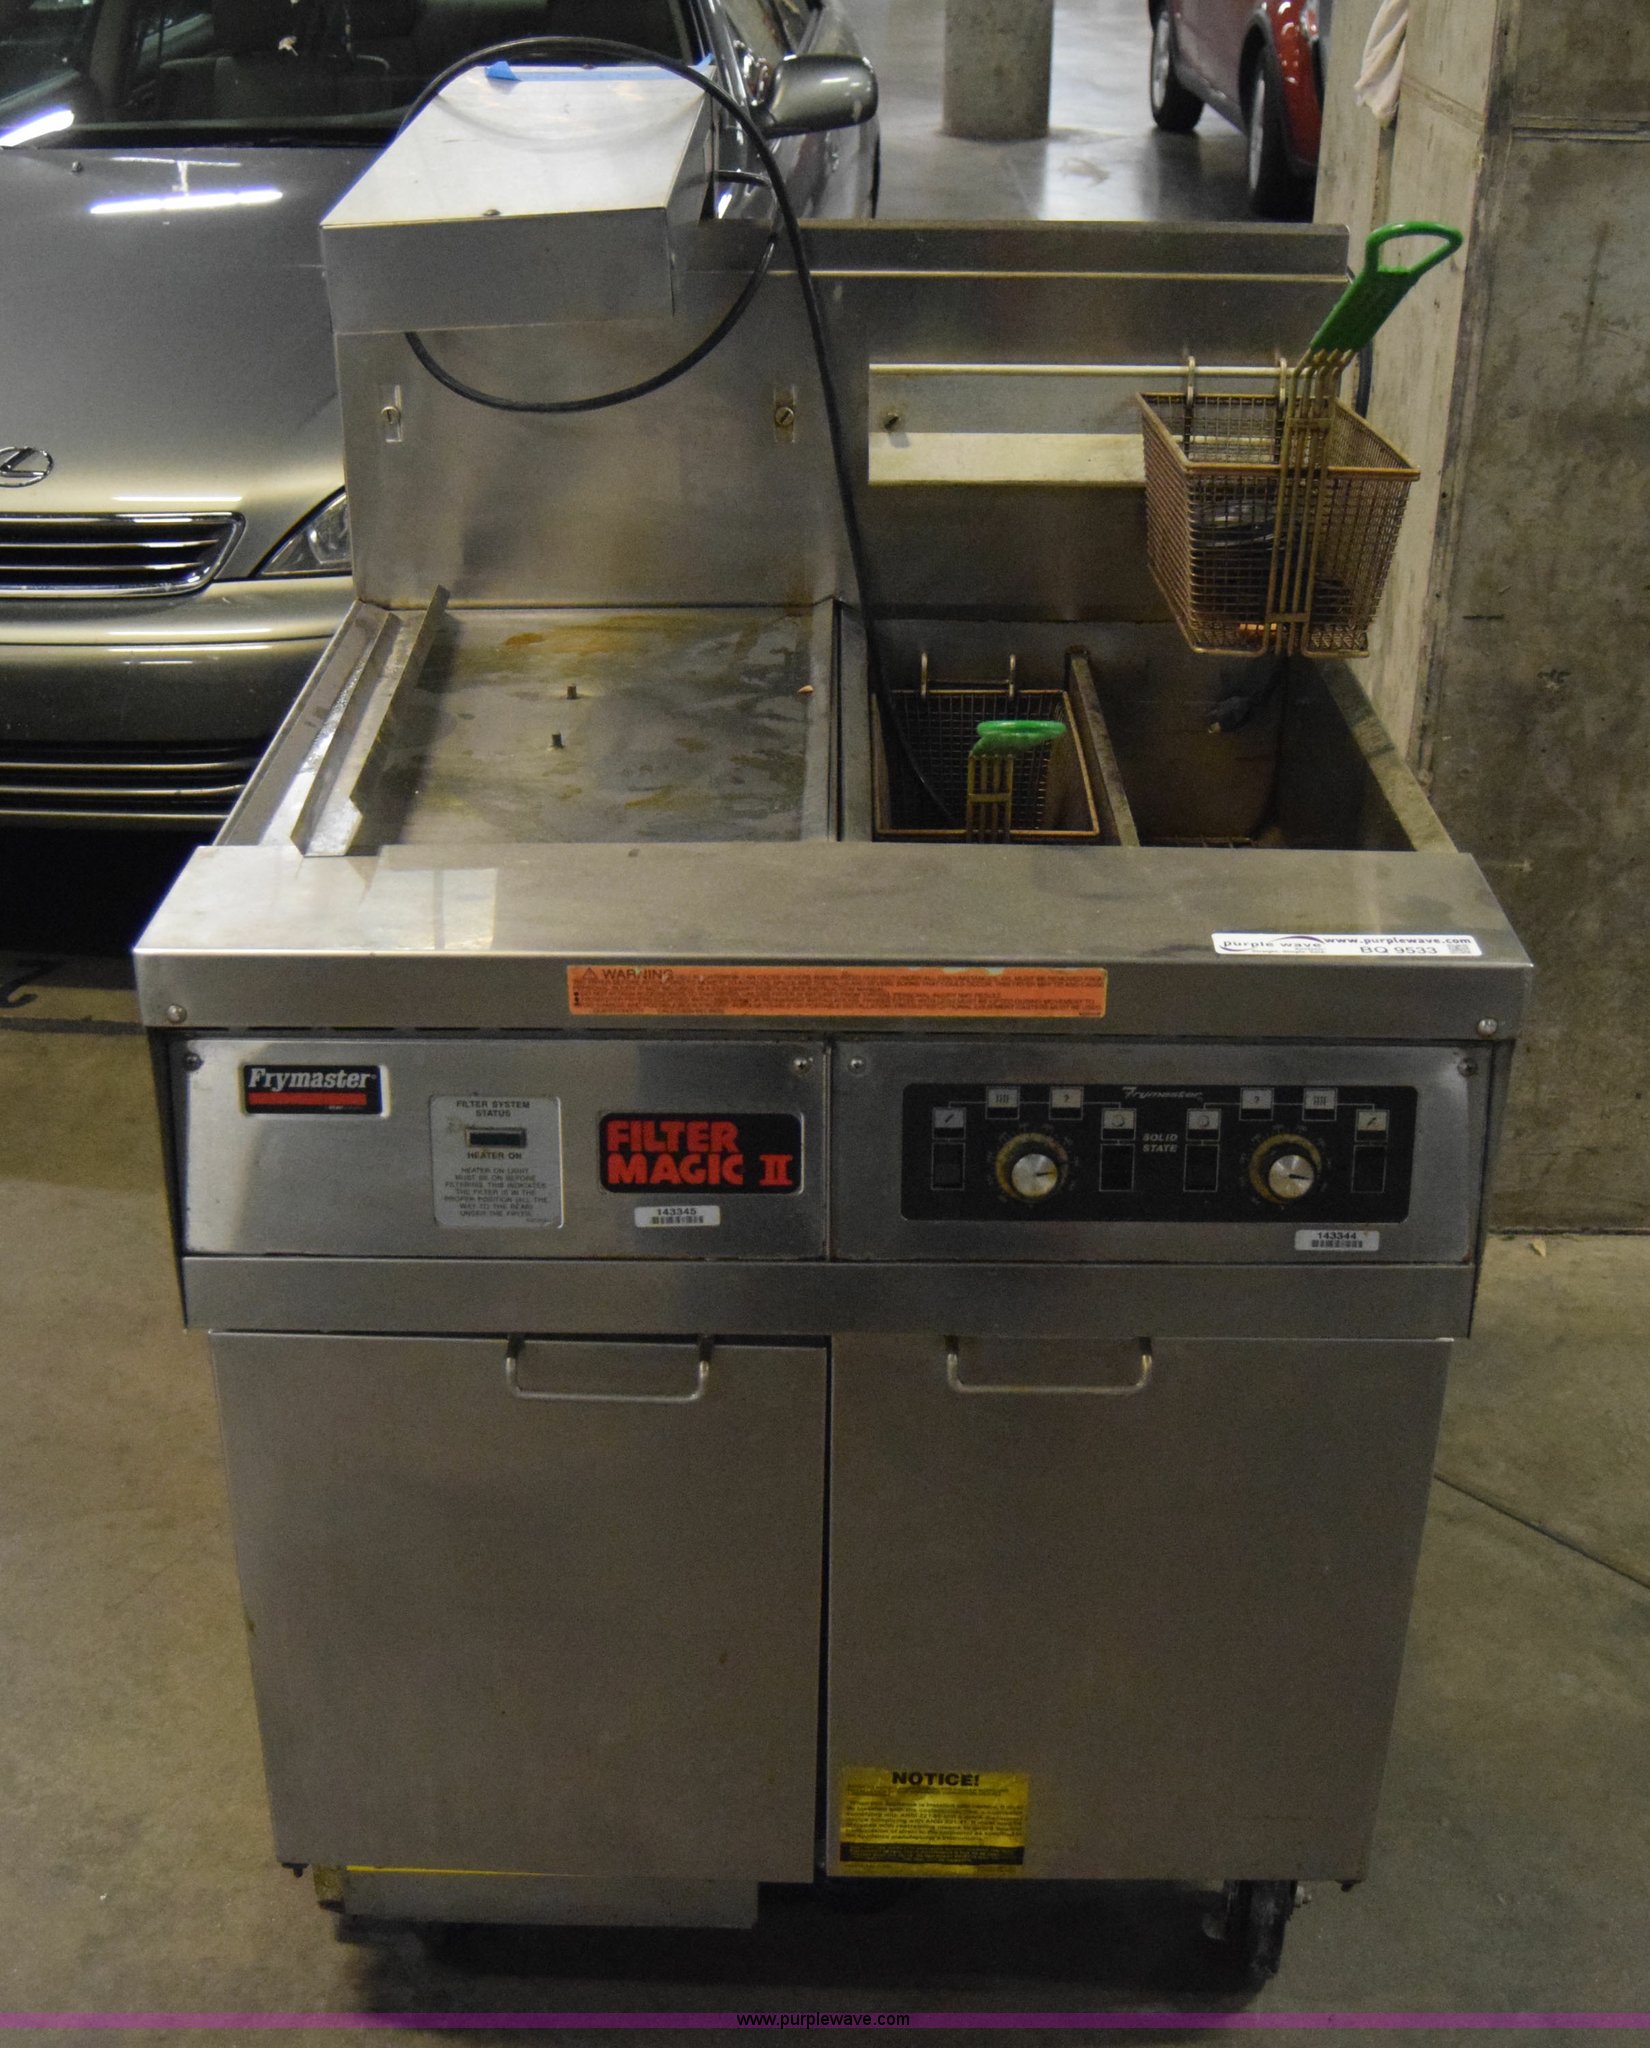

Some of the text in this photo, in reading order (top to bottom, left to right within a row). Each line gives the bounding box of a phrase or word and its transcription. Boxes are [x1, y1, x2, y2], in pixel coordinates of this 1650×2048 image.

[1223, 940, 1274, 948] purple
[1324, 937, 1471, 945] www.purplewave.com
[1360, 946, 1438, 954] BQ 9533
[248, 1067, 371, 1092] Frymaster
[456, 1100, 530, 1108] FILTER SYSTEM
[476, 1109, 511, 1117] STATUS
[607, 1120, 741, 1152] FILTER
[1142, 1133, 1178, 1142] SOLID
[1142, 1144, 1178, 1152] STATE
[467, 1151, 522, 1159] HEATER ON
[607, 1152, 793, 1187] MAGIC II
[656, 1208, 697, 1216] 143345
[1317, 1232, 1357, 1240] 143344
[891, 1771, 980, 1787] NOTICE!
